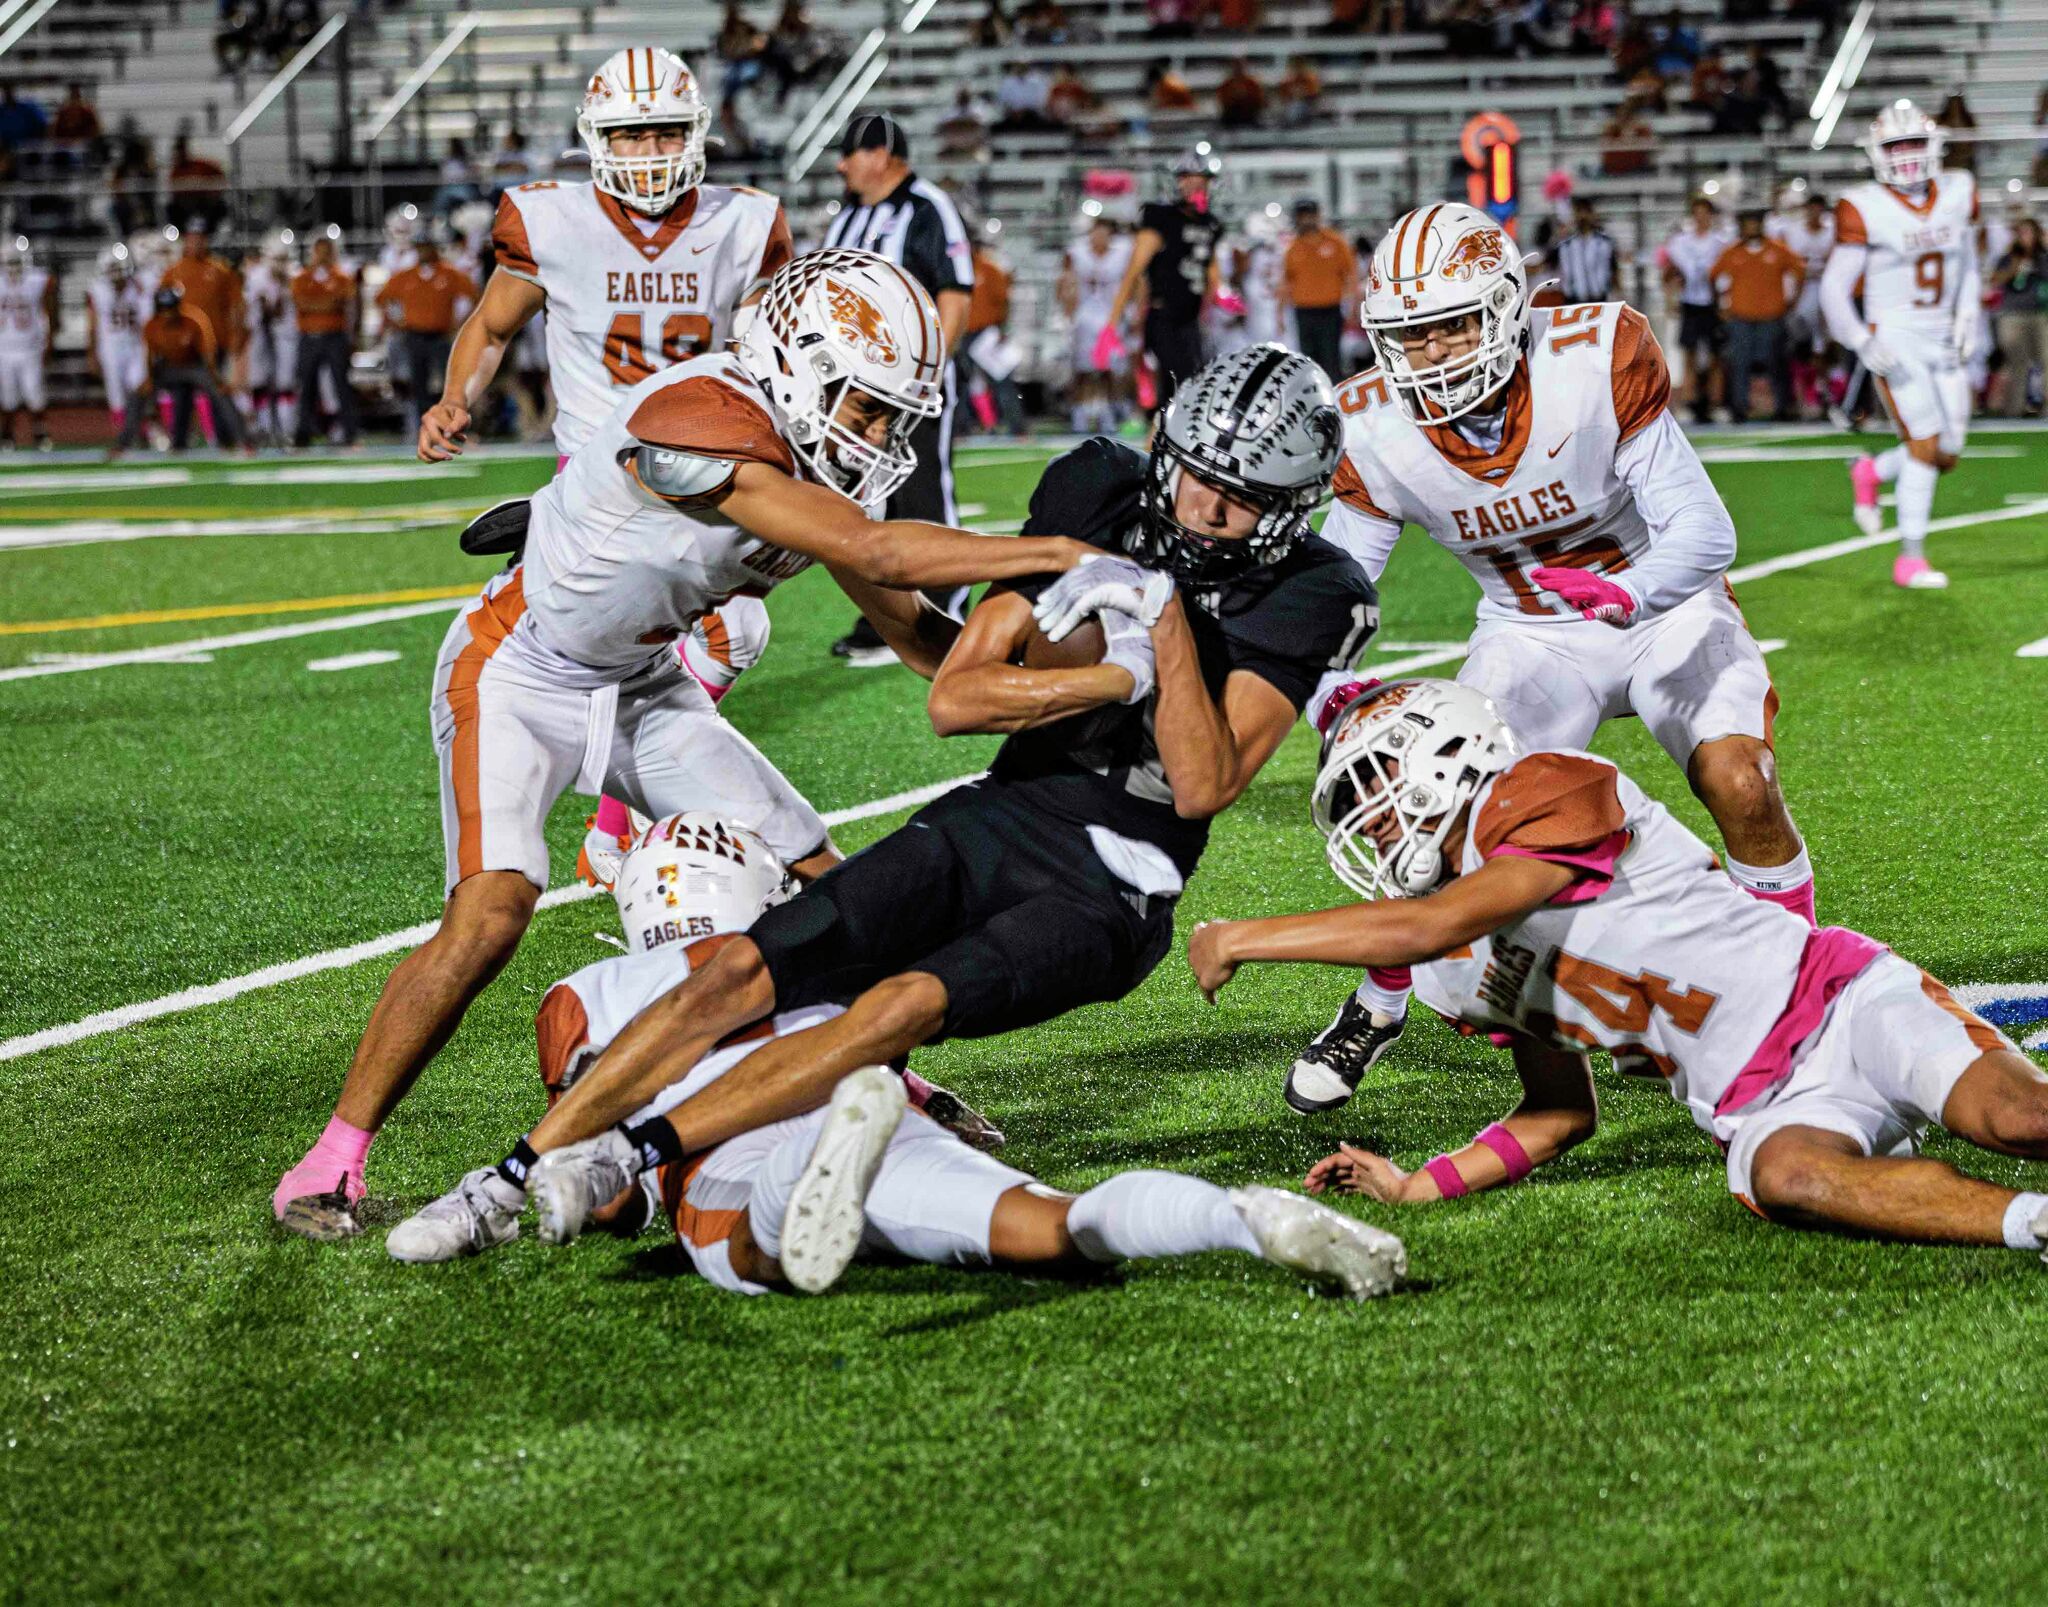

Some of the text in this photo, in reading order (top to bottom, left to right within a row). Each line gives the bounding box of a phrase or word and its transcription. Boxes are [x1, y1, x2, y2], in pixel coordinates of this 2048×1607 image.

[606, 271, 699, 304] EAGLES
[1913, 250, 1945, 309] 9
[1451, 479, 1578, 541] EAGLES
[643, 916, 715, 951] EAGLES
